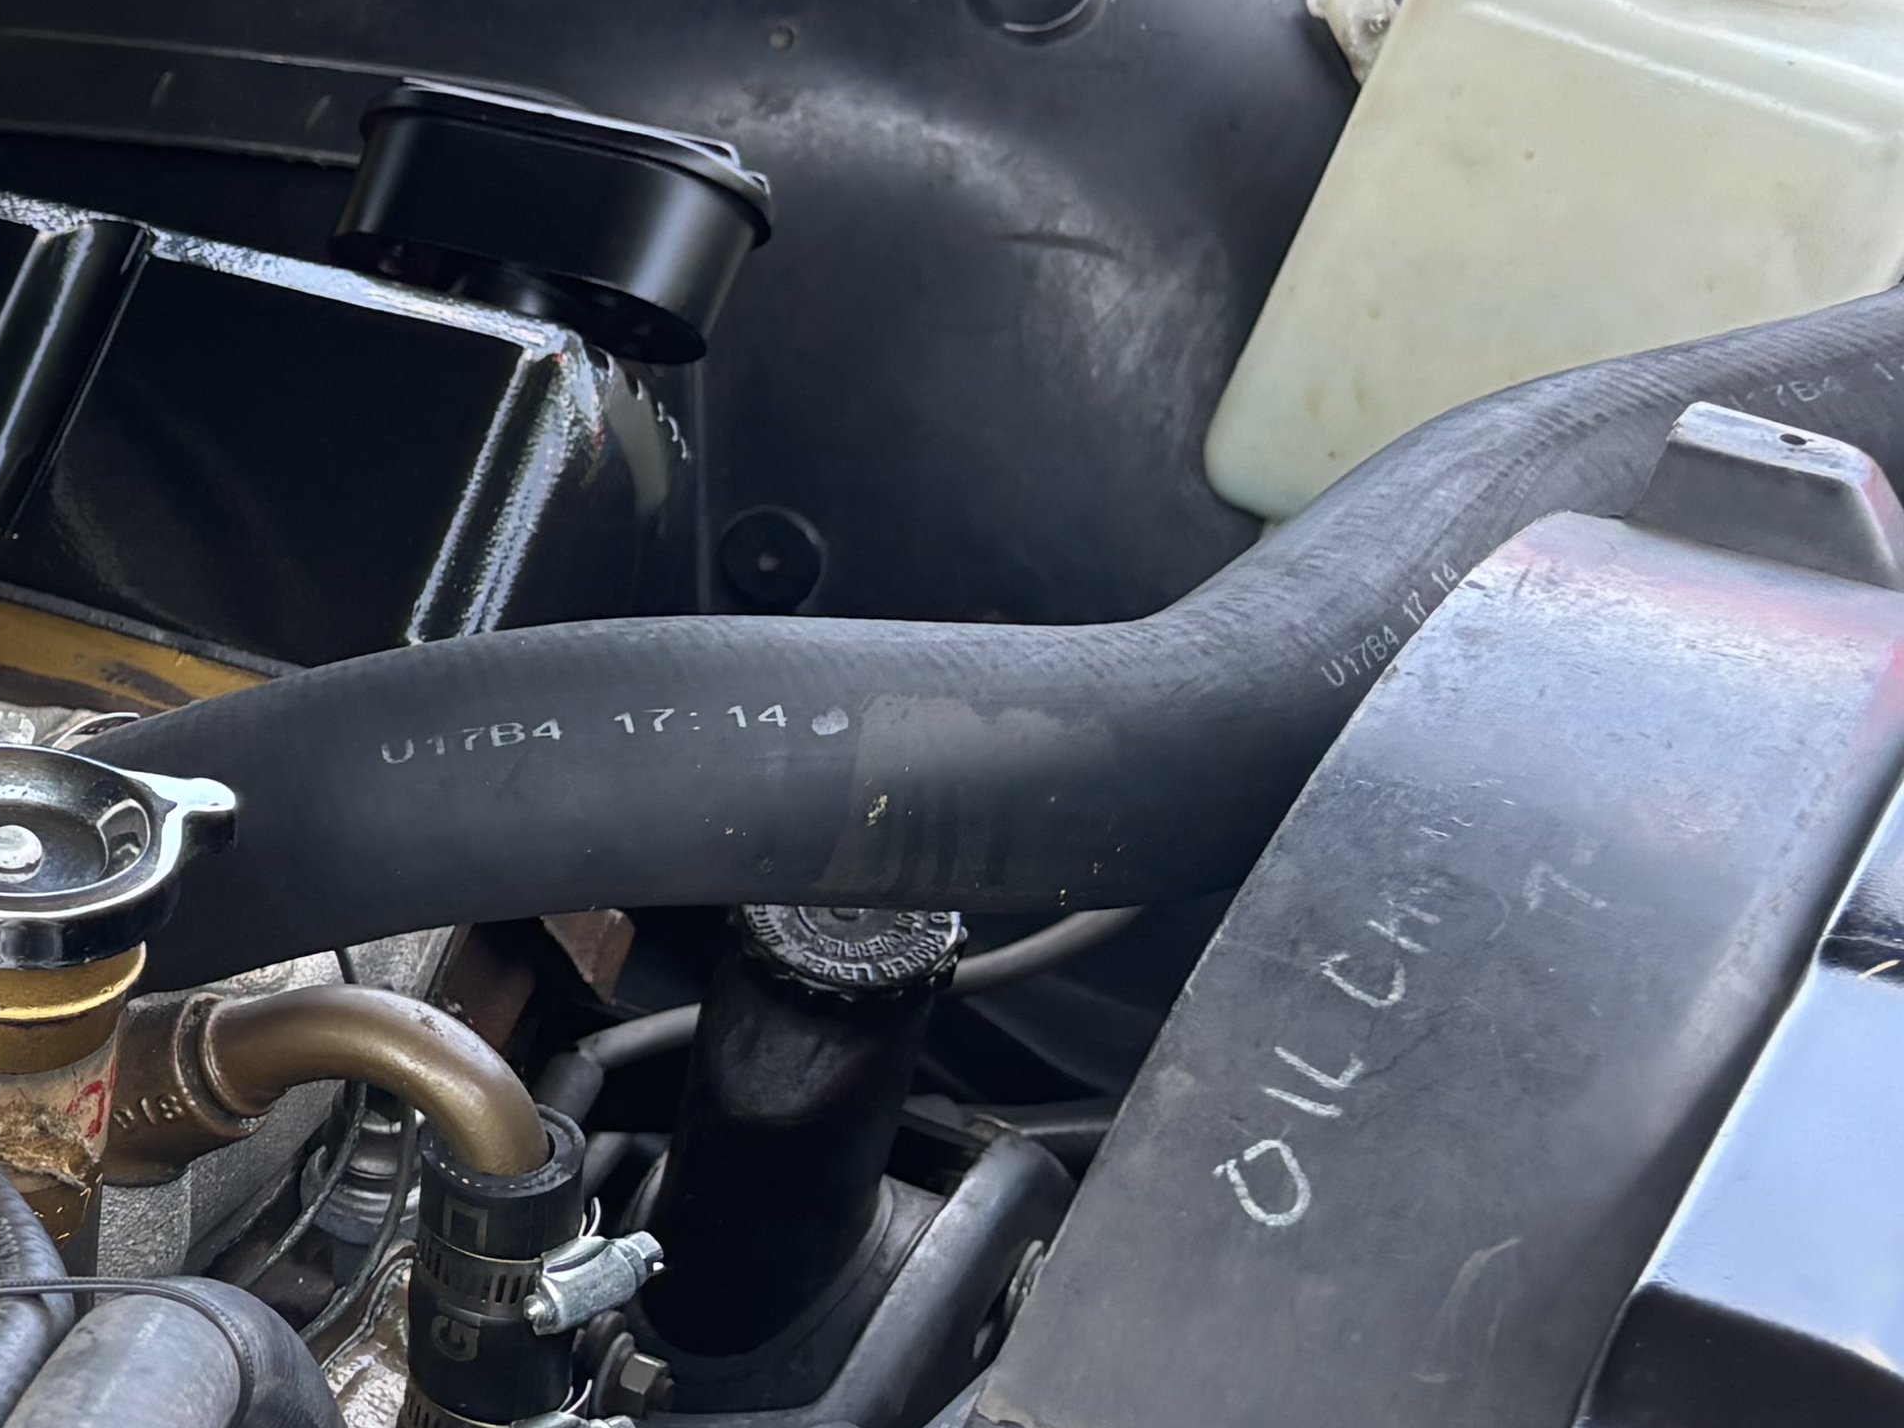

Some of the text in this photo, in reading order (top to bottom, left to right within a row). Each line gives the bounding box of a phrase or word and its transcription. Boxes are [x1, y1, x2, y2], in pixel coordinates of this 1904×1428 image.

[1320, 625, 1400, 688] U17B4
[380, 718, 563, 764] U17B4
[1212, 1045, 1366, 1228] OIL
